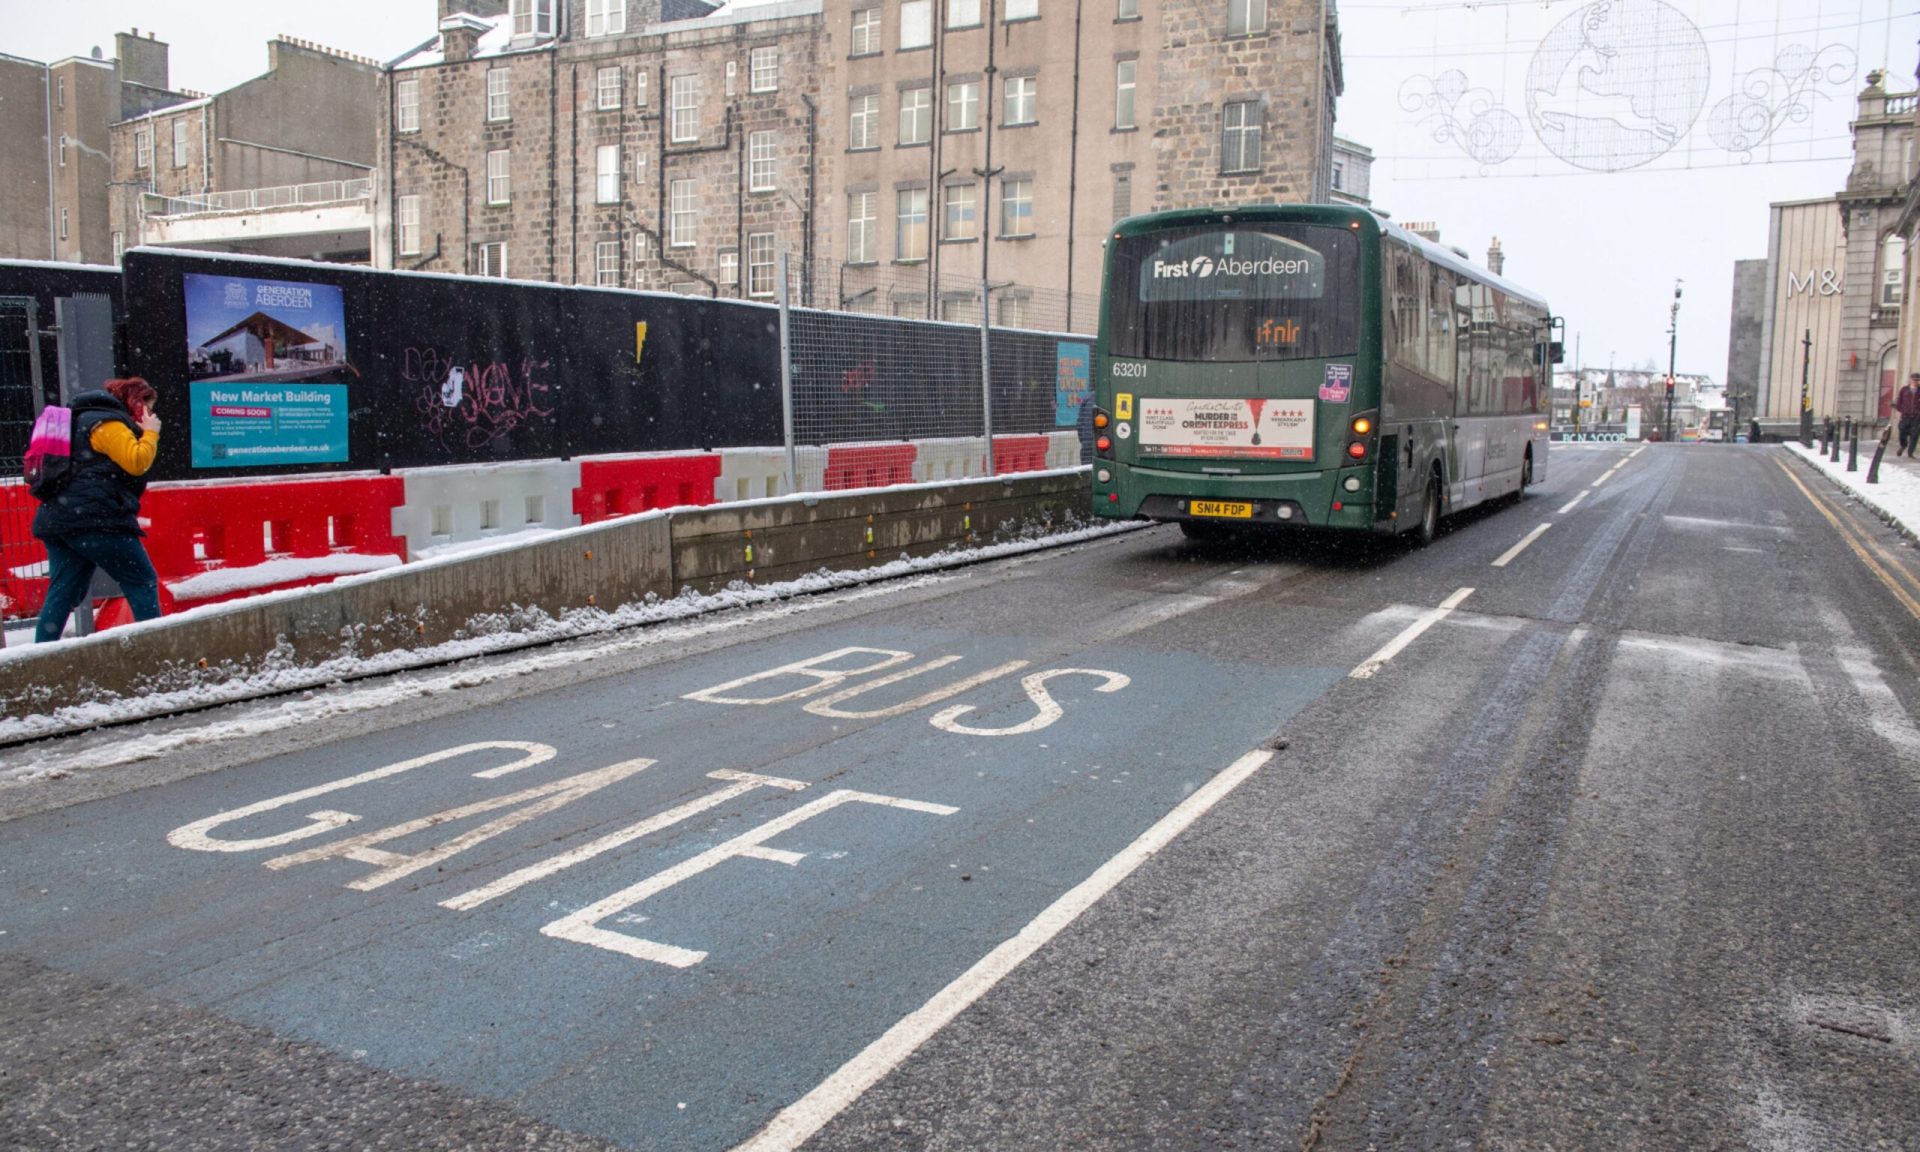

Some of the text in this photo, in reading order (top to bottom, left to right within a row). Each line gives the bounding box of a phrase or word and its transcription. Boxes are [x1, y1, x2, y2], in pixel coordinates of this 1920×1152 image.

[1154, 257, 1309, 278] First Aberdeen
[1787, 268, 1843, 298] M&
[256, 285, 312, 297] GENERATION
[255, 294, 312, 309] ABERDEEN
[1112, 363, 1147, 377] 63201
[211, 390, 331, 405] New Market Building
[216, 408, 267, 416] COMING SOON
[1194, 412, 1230, 420] MURDER
[1182, 420, 1249, 430] ORIENT EXPRESS
[227, 443, 330, 456] generationaberdeen.co.uk
[1197, 503, 1245, 515] SN14 FDP
[682, 646, 1131, 737] BUS
[167, 740, 961, 969] GATE
